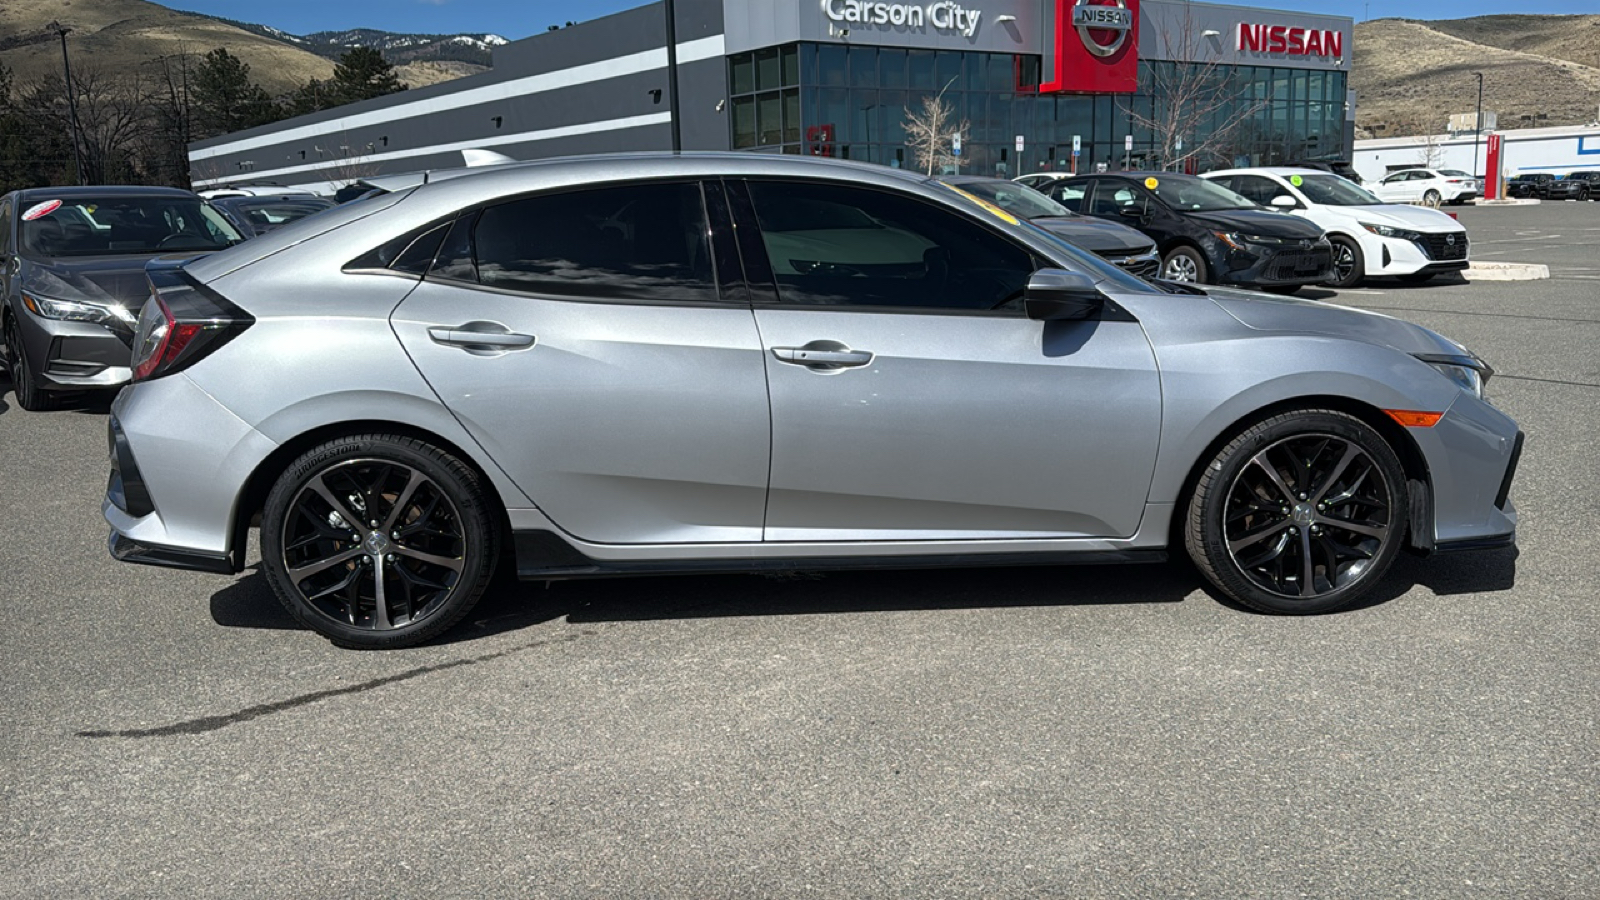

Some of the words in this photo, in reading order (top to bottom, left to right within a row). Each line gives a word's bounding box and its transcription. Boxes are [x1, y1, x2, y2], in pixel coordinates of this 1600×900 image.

[821, 0, 923, 26] Carson
[927, 1, 981, 37] City
[1082, 9, 1129, 24] NISSAN
[1238, 23, 1342, 57] NISSAN
